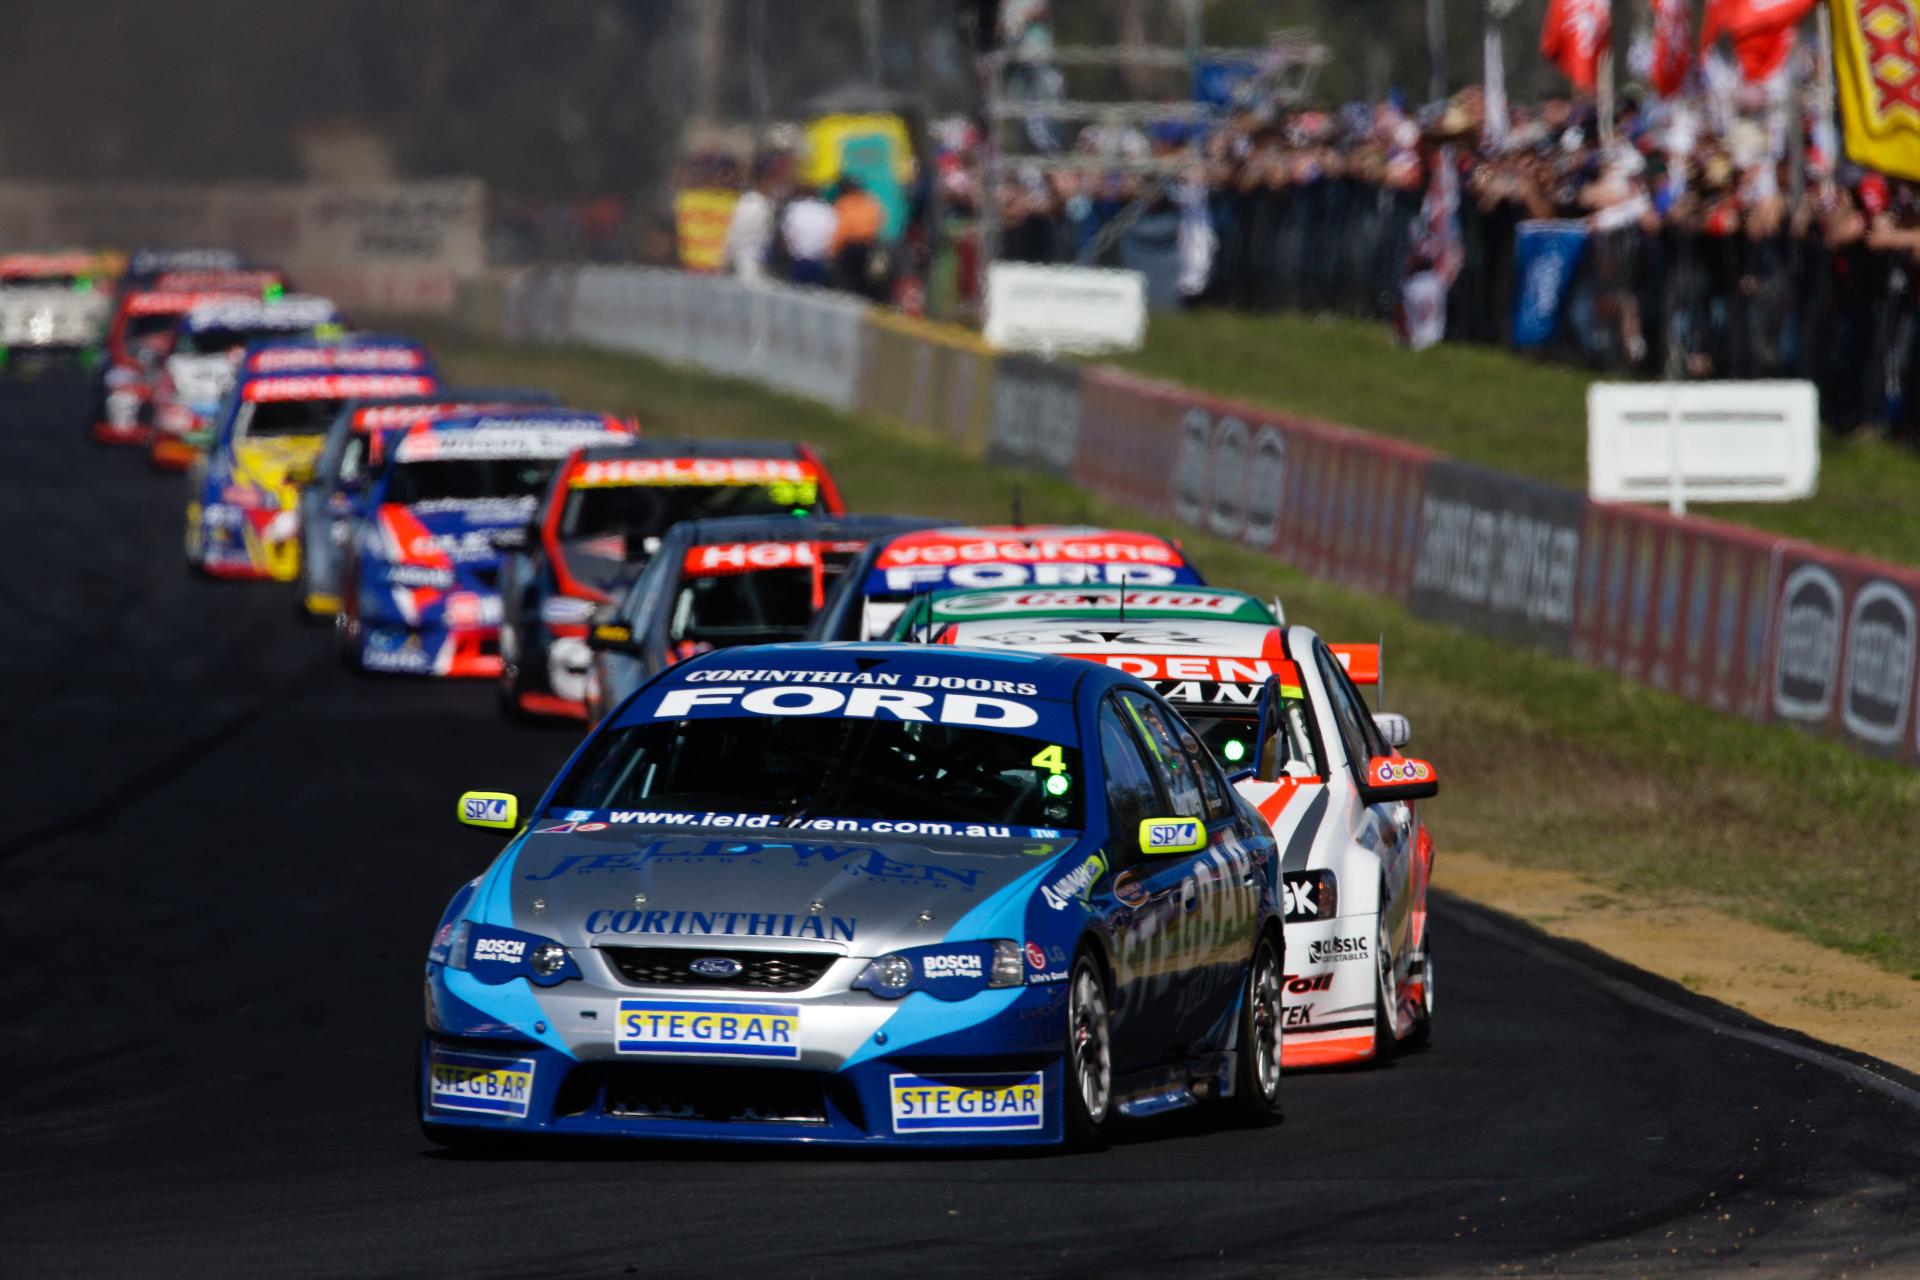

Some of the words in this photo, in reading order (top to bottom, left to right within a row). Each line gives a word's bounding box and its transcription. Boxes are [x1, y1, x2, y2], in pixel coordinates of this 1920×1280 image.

[583, 459, 801, 483] HOLDEN
[702, 543, 815, 568] HOL
[889, 541, 1172, 564] vodafone
[886, 563, 1176, 590] FORD
[1013, 591, 1225, 608] Castrol
[1106, 656, 1272, 683] DEN
[685, 669, 902, 685] CORINTHIAN
[913, 674, 1038, 696] DOORS
[1144, 680, 1265, 704] AN
[653, 686, 1039, 728] FORD
[1031, 745, 1066, 774] 4
[1379, 760, 1429, 782] dodo
[585, 908, 856, 941] CORINTHIAN
[473, 951, 498, 961] Spark
[499, 953, 523, 964] Plugs
[475, 938, 526, 955] BOSCH
[923, 955, 983, 970] BOSCH
[925, 968, 954, 979] Spark
[955, 968, 983, 979] Plugs
[1282, 1003, 1315, 1025] TEK
[626, 1013, 790, 1043] STEGBAR
[435, 1067, 527, 1100] STEGBAR
[901, 1088, 1036, 1115] STEGBAR
